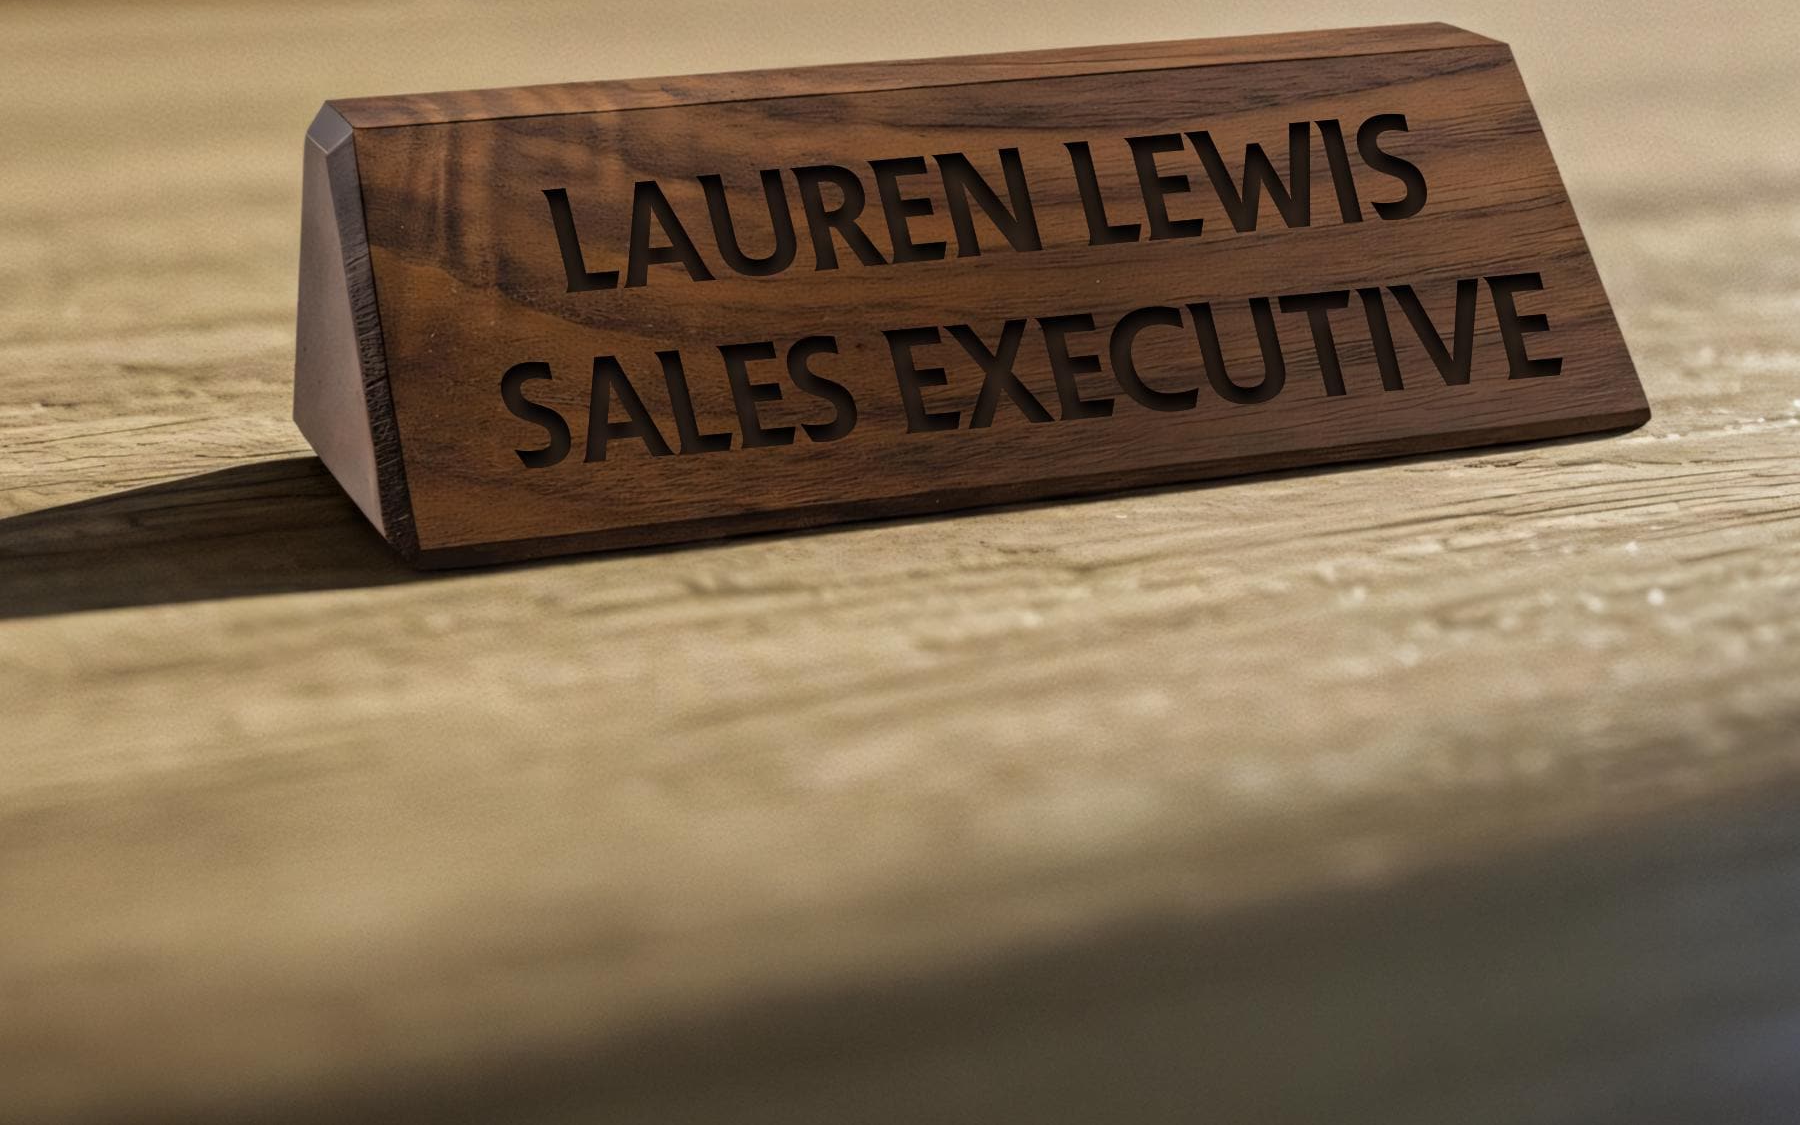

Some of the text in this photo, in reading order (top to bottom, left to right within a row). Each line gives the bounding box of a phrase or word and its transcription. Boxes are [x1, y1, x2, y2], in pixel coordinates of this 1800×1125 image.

[541, 113, 1428, 293] LAUREN LEWIS
[500, 272, 1563, 469] SALES EXECUTIVE
